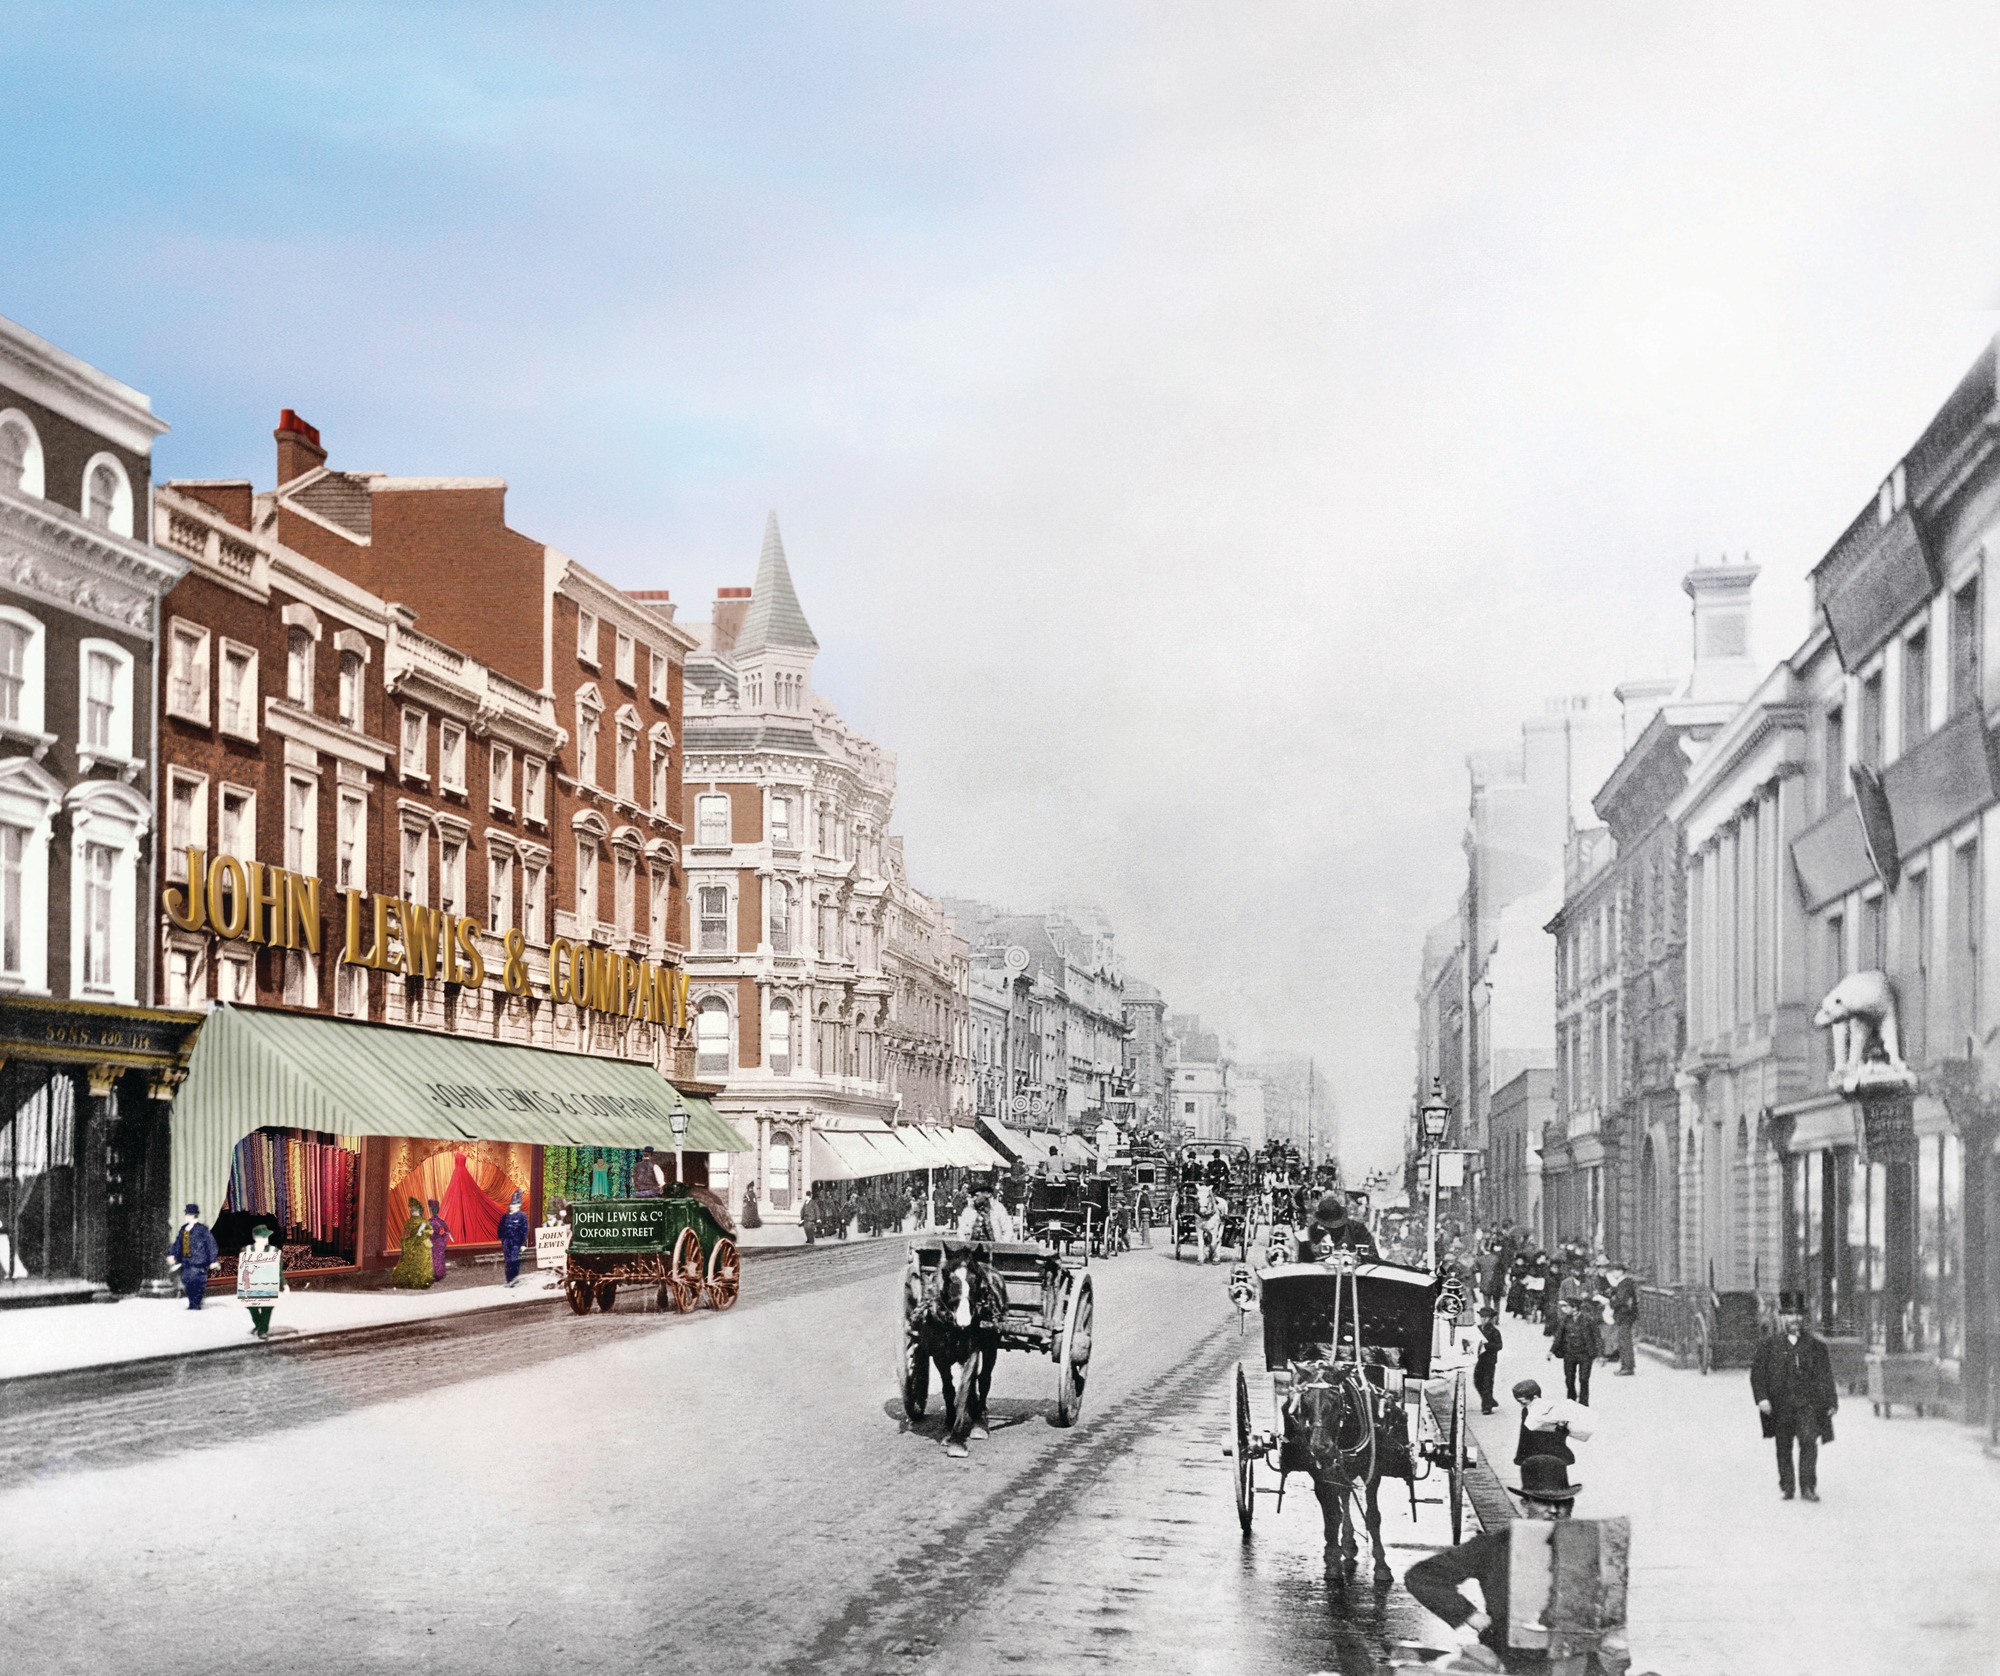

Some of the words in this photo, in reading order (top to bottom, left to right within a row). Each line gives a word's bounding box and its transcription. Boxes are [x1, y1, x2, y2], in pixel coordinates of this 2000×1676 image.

[163, 845, 321, 954] JOHN
[344, 888, 484, 988] LEWIS
[503, 928, 533, 998] &
[550, 938, 690, 1029] COMPANY
[425, 1083, 498, 1110] JOHN
[485, 1087, 560, 1114] LEWIS
[551, 1092, 582, 1116] &
[570, 1093, 667, 1120] COMPANY
[575, 1212, 604, 1225] JOHN
[607, 1211, 637, 1222] LEWIS
[640, 1211, 648, 1222] &
[540, 1231, 564, 1240] JOHN
[580, 1228, 619, 1238] OXFORD
[621, 1227, 654, 1237] STREET
[538, 1241, 565, 1249] LEWIS
